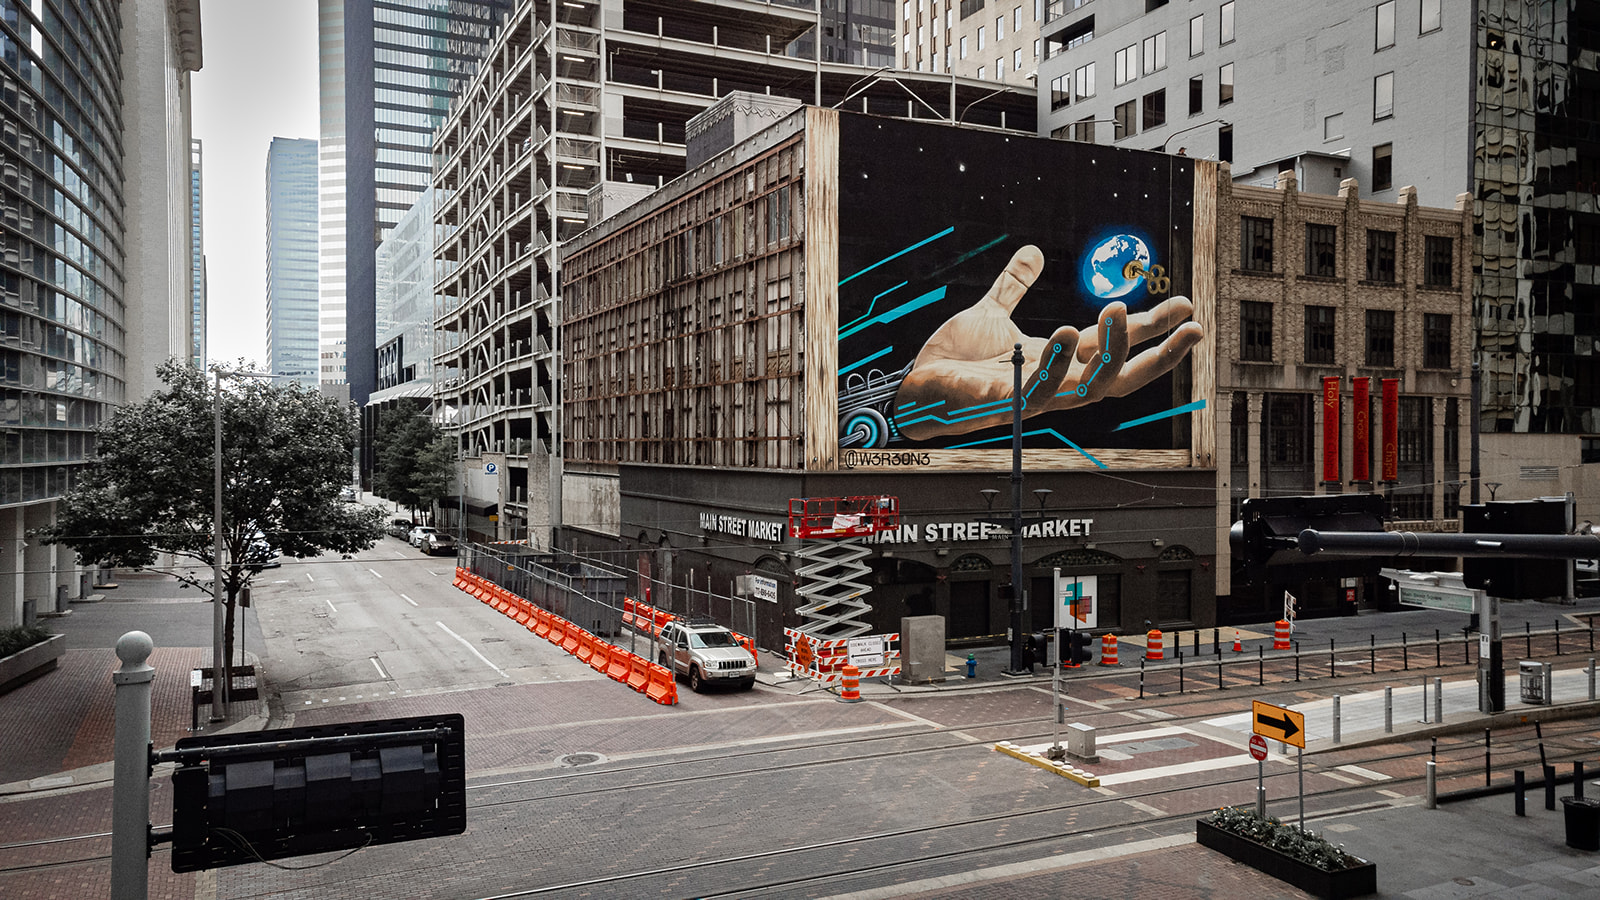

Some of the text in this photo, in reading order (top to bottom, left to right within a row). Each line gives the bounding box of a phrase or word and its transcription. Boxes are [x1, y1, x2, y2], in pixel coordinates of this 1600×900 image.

[1325, 382, 1337, 408] Holy
[1357, 411, 1366, 439] Cross
[1384, 443, 1396, 477] Chapel
[700, 512, 783, 542] MAIN STREET MARKET
